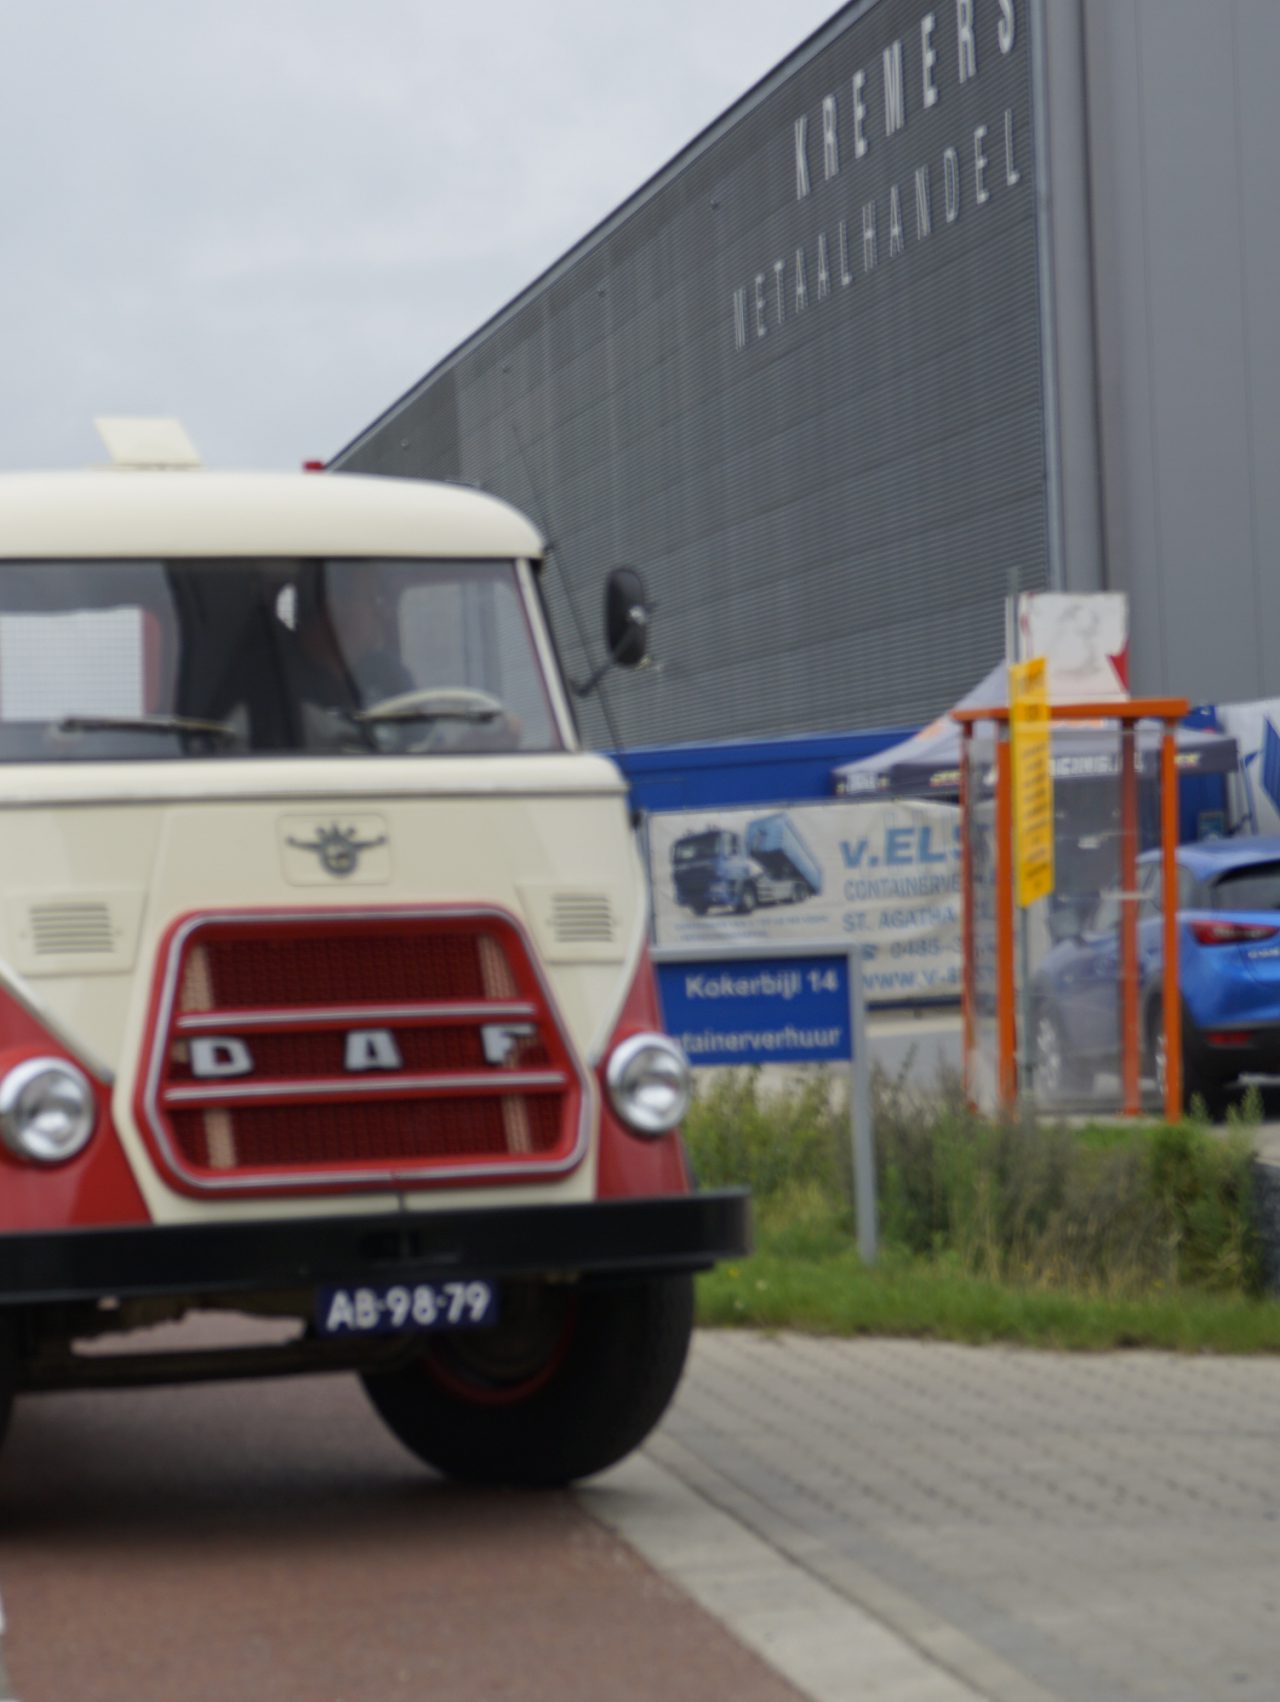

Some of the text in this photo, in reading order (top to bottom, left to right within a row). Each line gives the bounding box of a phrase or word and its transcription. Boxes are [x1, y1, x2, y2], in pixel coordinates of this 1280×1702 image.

[794, 0, 1015, 200] KREMERS
[733, 108, 1020, 352] METAALHANDEL
[843, 872, 962, 901] CONTAINERVE
[879, 905, 957, 929] AGATHA
[684, 969, 838, 999] Kokerbijl 14
[189, 1023, 536, 1078] DAF
[326, 1281, 492, 1332] AB-98-79
